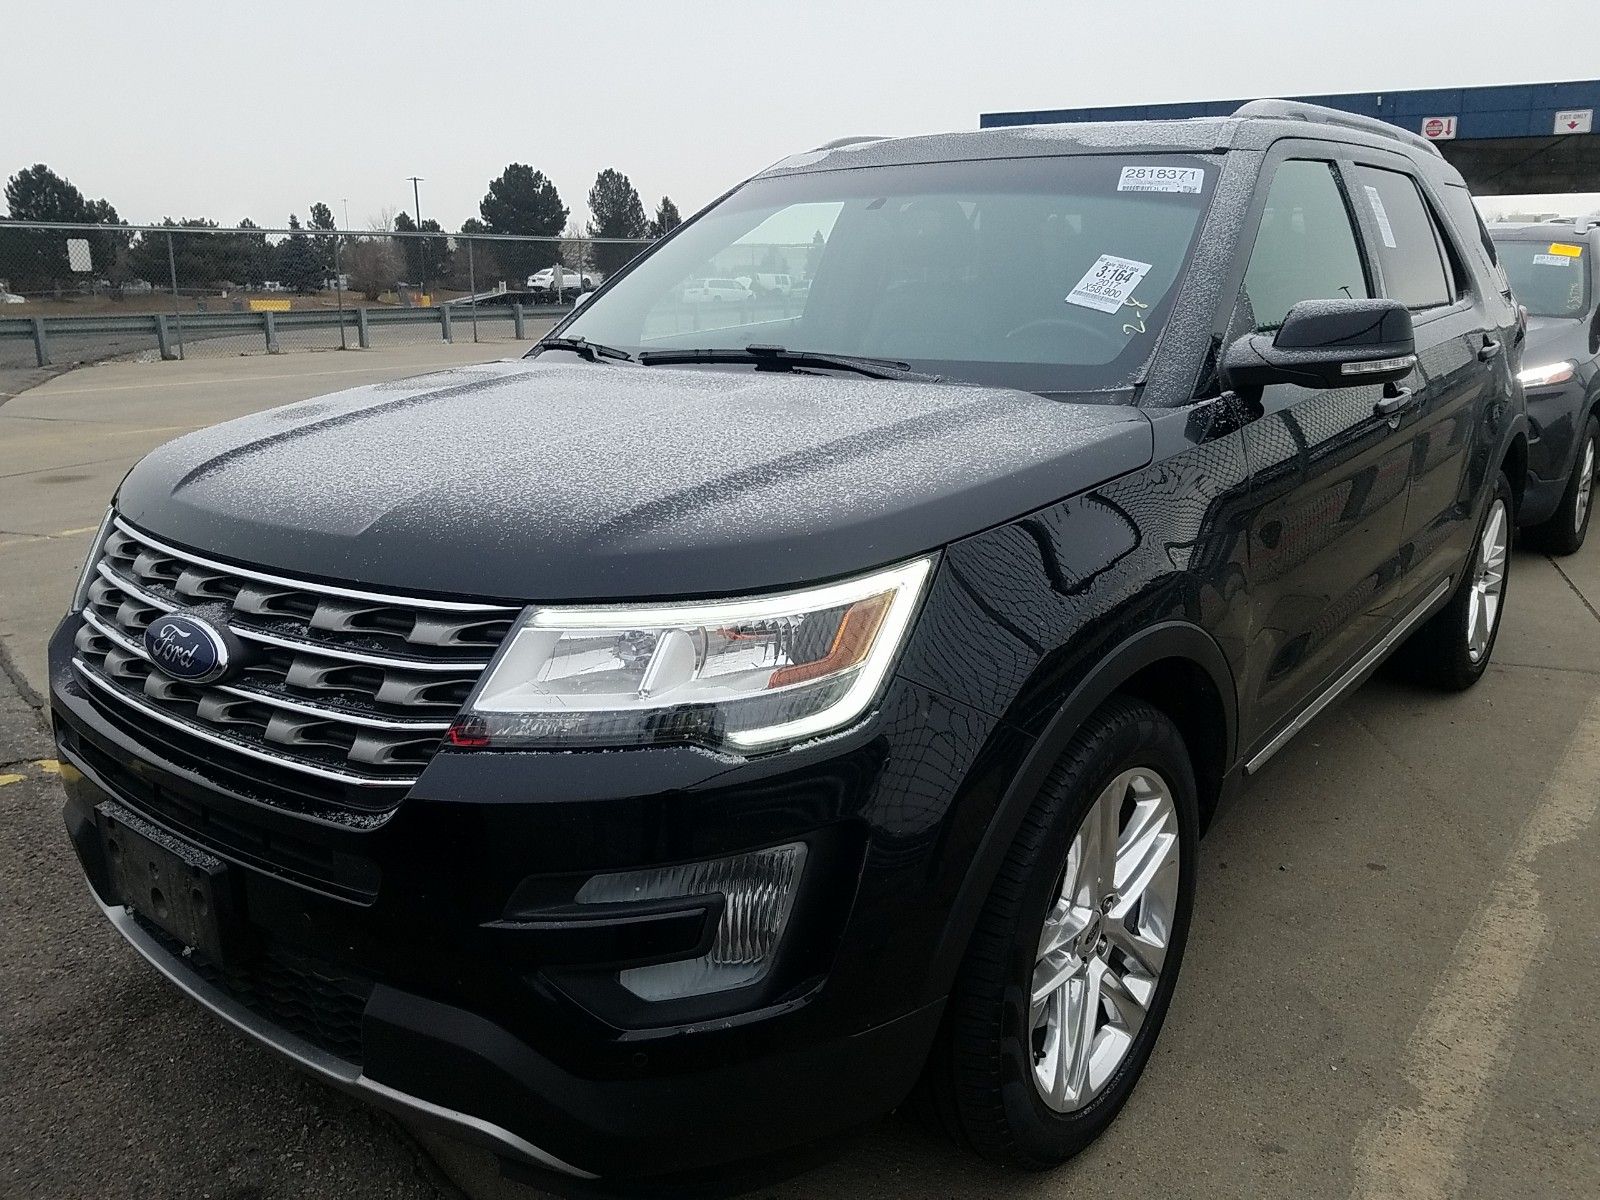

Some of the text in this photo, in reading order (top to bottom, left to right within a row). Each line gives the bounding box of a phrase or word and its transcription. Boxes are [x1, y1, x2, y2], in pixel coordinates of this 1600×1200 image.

[1573, 112, 1589, 120] ONLY
[1125, 168, 1196, 181] 2818371
[1096, 265, 1134, 283] 3:164
[1096, 278, 1121, 289] 2017
[153, 624, 199, 668] Ford
